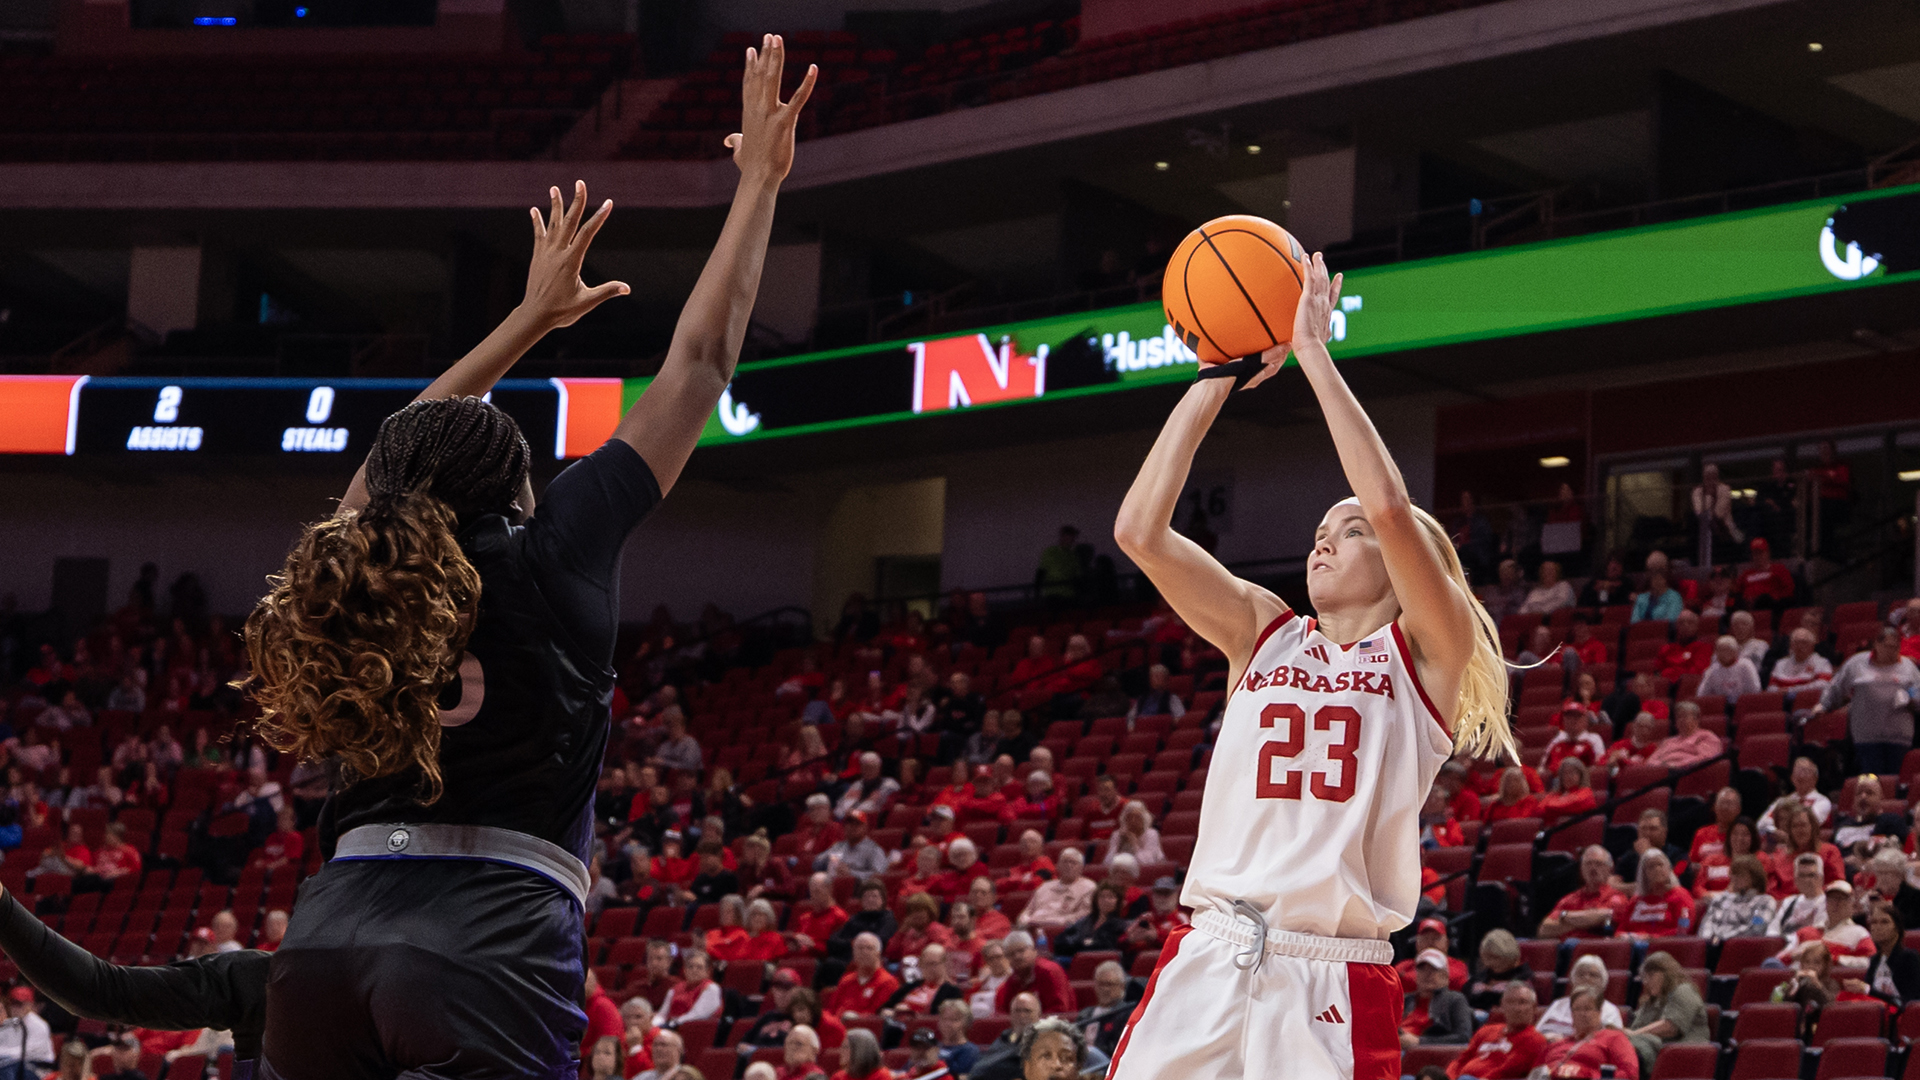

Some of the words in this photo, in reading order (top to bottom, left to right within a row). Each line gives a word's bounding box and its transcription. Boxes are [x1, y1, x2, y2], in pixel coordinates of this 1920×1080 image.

[154, 386, 183, 423] 2
[305, 386, 335, 424] 0
[126, 426, 203, 451] ASSISTS
[281, 427, 349, 452] STEALS
[1240, 665, 1395, 701] NEBRASKA
[1256, 702, 1362, 803] 23
